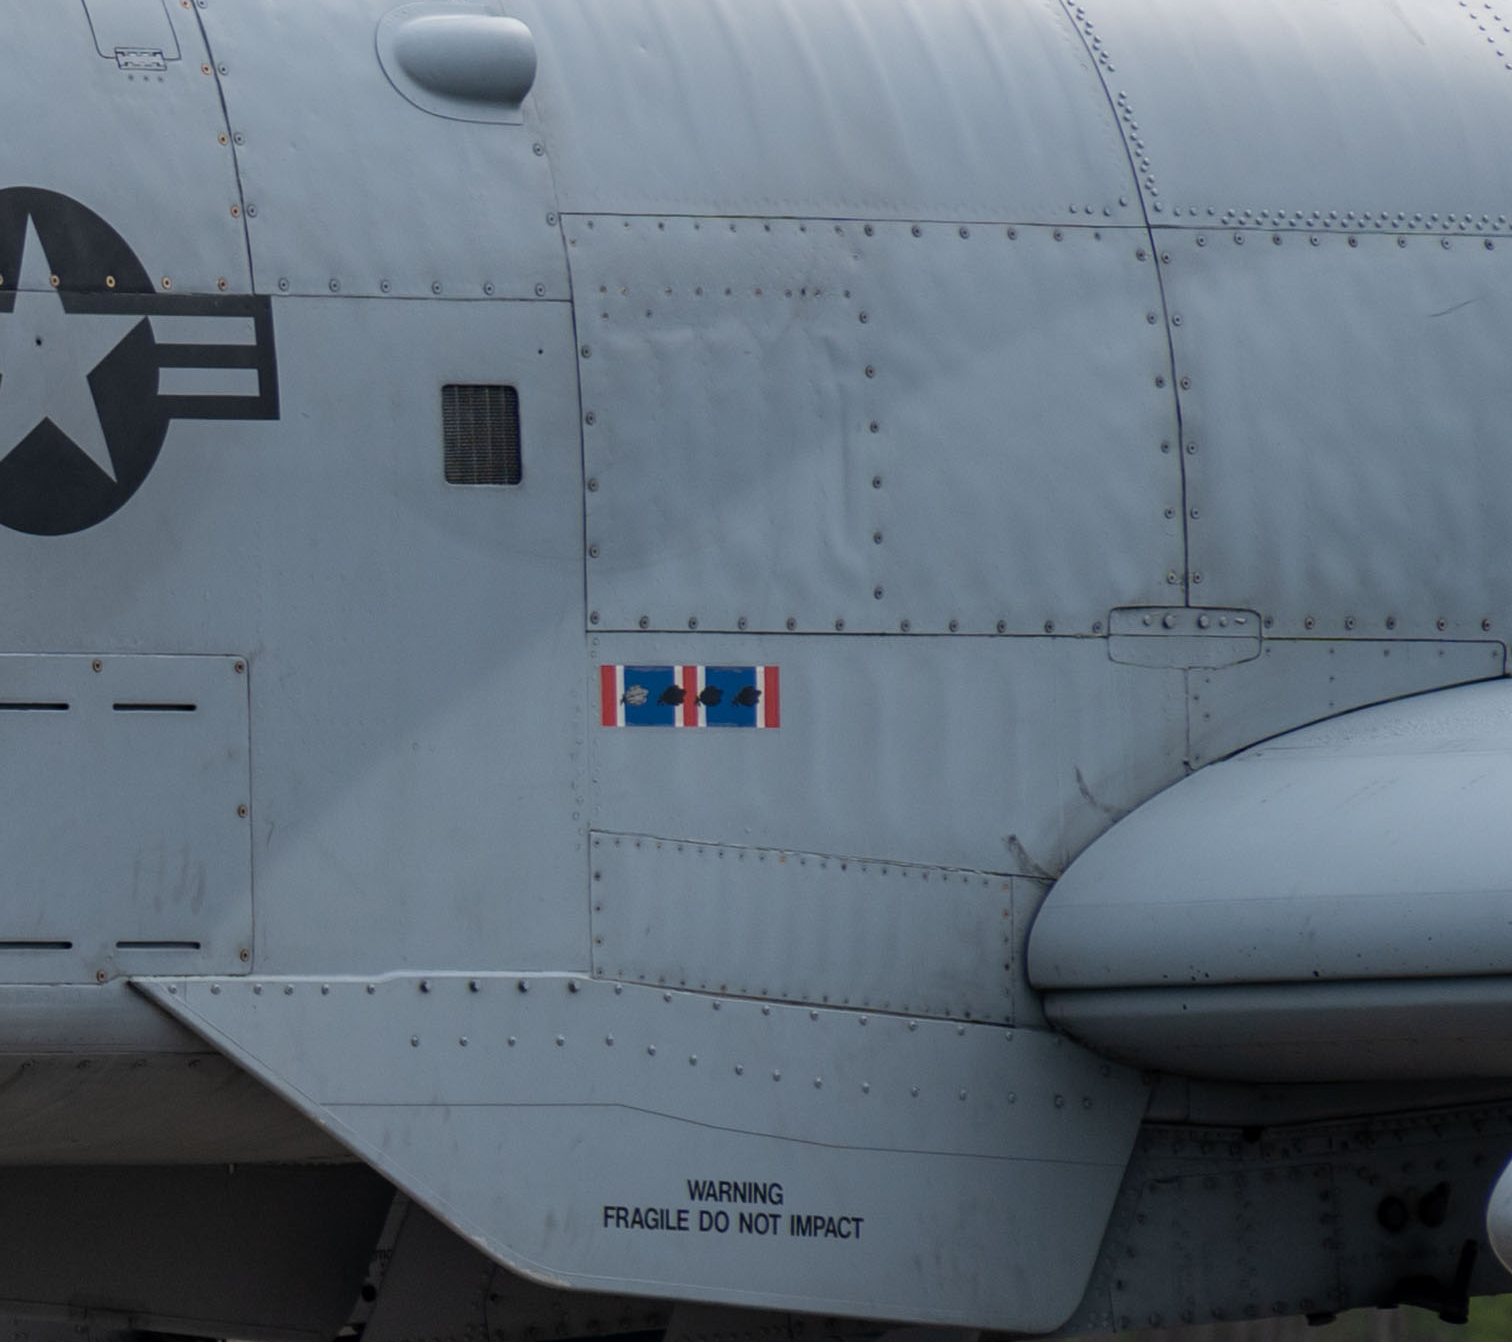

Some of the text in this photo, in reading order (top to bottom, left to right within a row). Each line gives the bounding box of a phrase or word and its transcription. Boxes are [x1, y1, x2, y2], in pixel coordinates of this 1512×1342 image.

[687, 1179, 784, 1205] WARNING
[603, 1206, 864, 1239] FRAGILE DO NOT IMPACT
